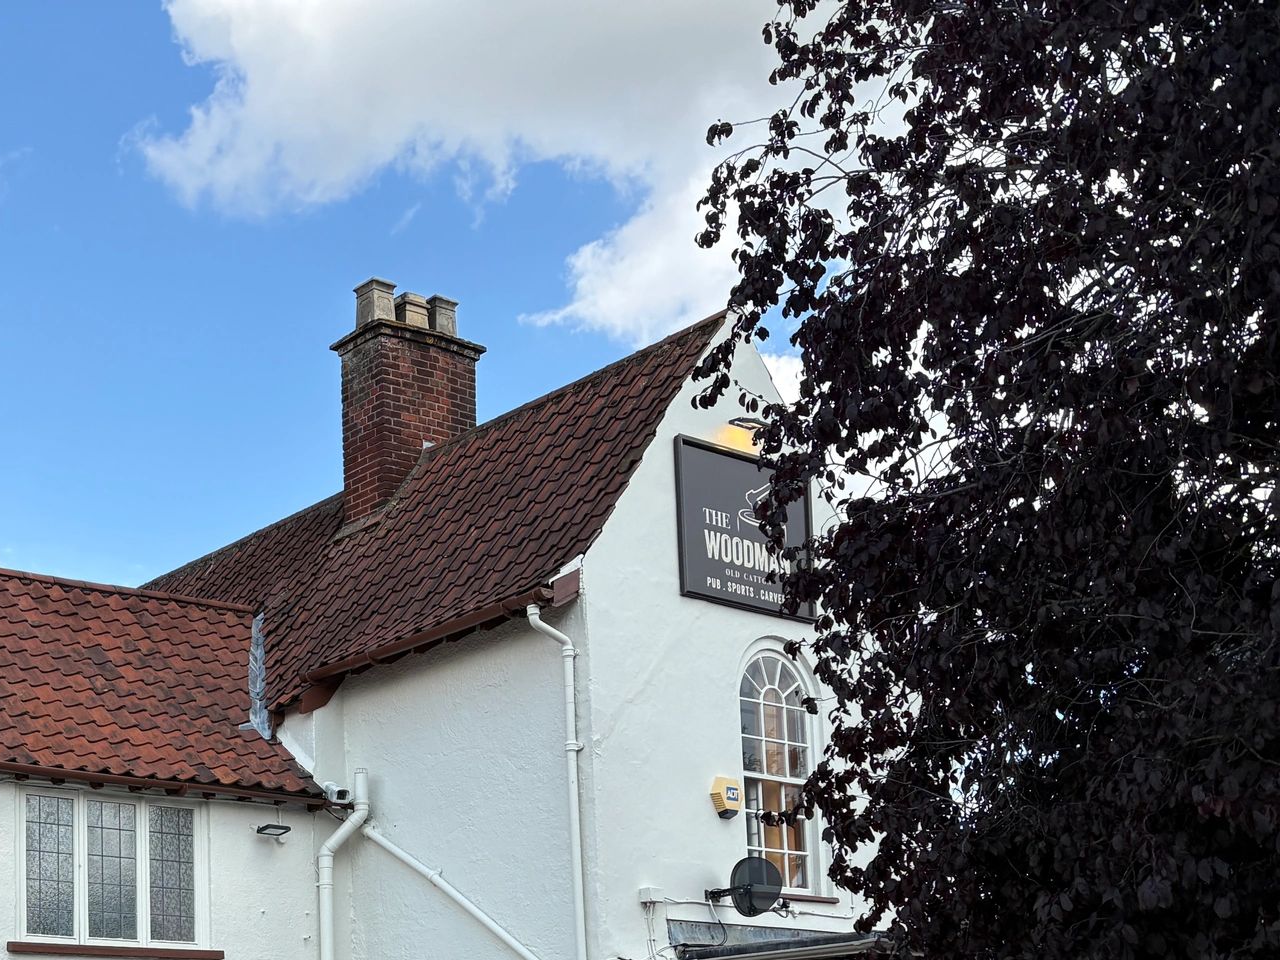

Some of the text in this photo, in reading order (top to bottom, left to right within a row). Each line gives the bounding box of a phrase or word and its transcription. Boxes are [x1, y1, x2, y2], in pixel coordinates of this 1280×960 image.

[703, 507, 730, 529] THE
[706, 576, 721, 590] PUB
[727, 581, 754, 598] SPORTS
[725, 568, 772, 586] OLD CATTO
[727, 789, 739, 799] ADT
